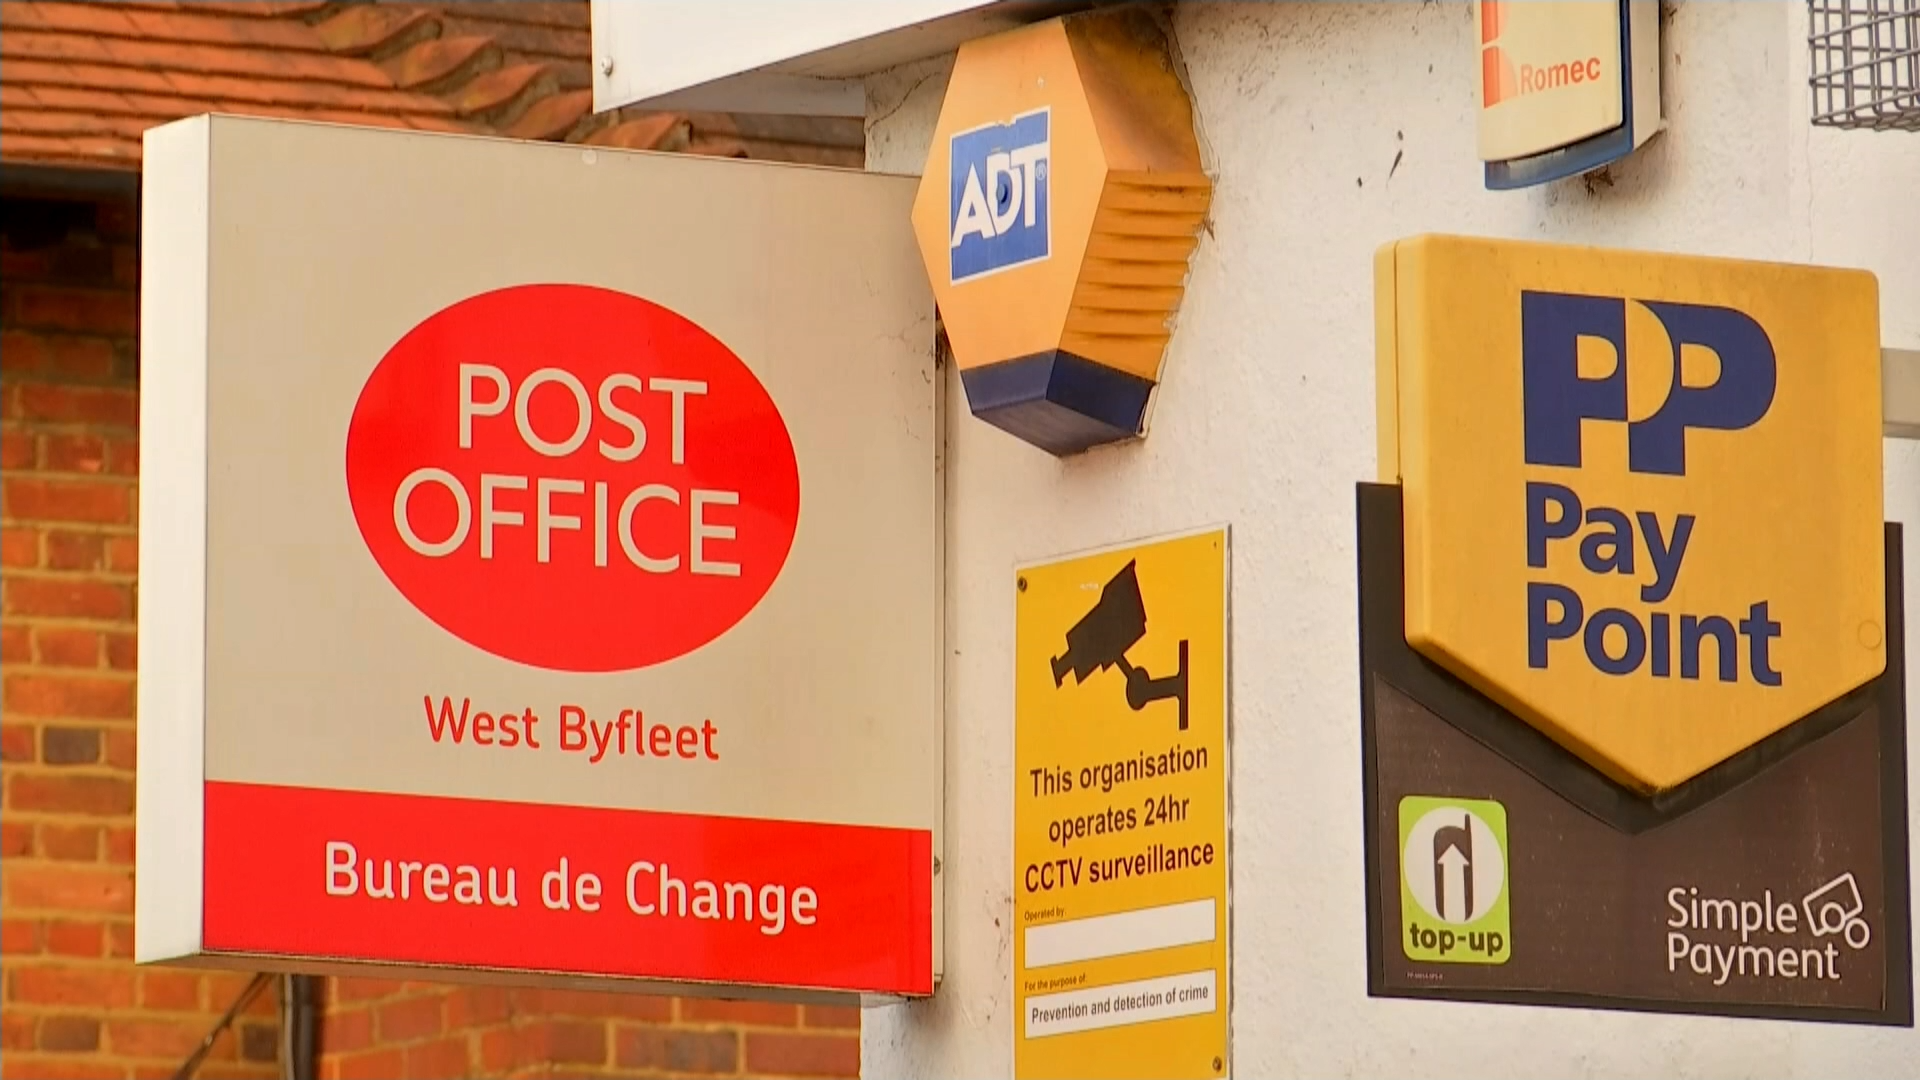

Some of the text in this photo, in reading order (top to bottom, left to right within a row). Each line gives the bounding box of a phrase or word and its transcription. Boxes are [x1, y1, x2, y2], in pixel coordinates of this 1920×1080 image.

[1520, 57, 1601, 95] Romec
[458, 362, 708, 465] POST
[393, 467, 741, 577] OFFICE
[1525, 480, 1696, 604] Pay
[1527, 581, 1783, 687] Point
[423, 695, 720, 764] West Byfleet
[1030, 744, 1208, 797] This organisation
[1048, 793, 1190, 848] operates 24hr
[325, 840, 818, 936] Bureau de Change
[1025, 842, 1214, 893] CCTV surveillance
[1024, 905, 1055, 922] Operated
[1409, 922, 1504, 957] top-up
[1667, 886, 1798, 943] Simple
[1024, 981, 1036, 992] For
[1037, 979, 1048, 990] the
[1049, 976, 1077, 991] purpose
[1667, 931, 1841, 986] Payment
[1031, 984, 1209, 1024] Prevention and detection of crime
